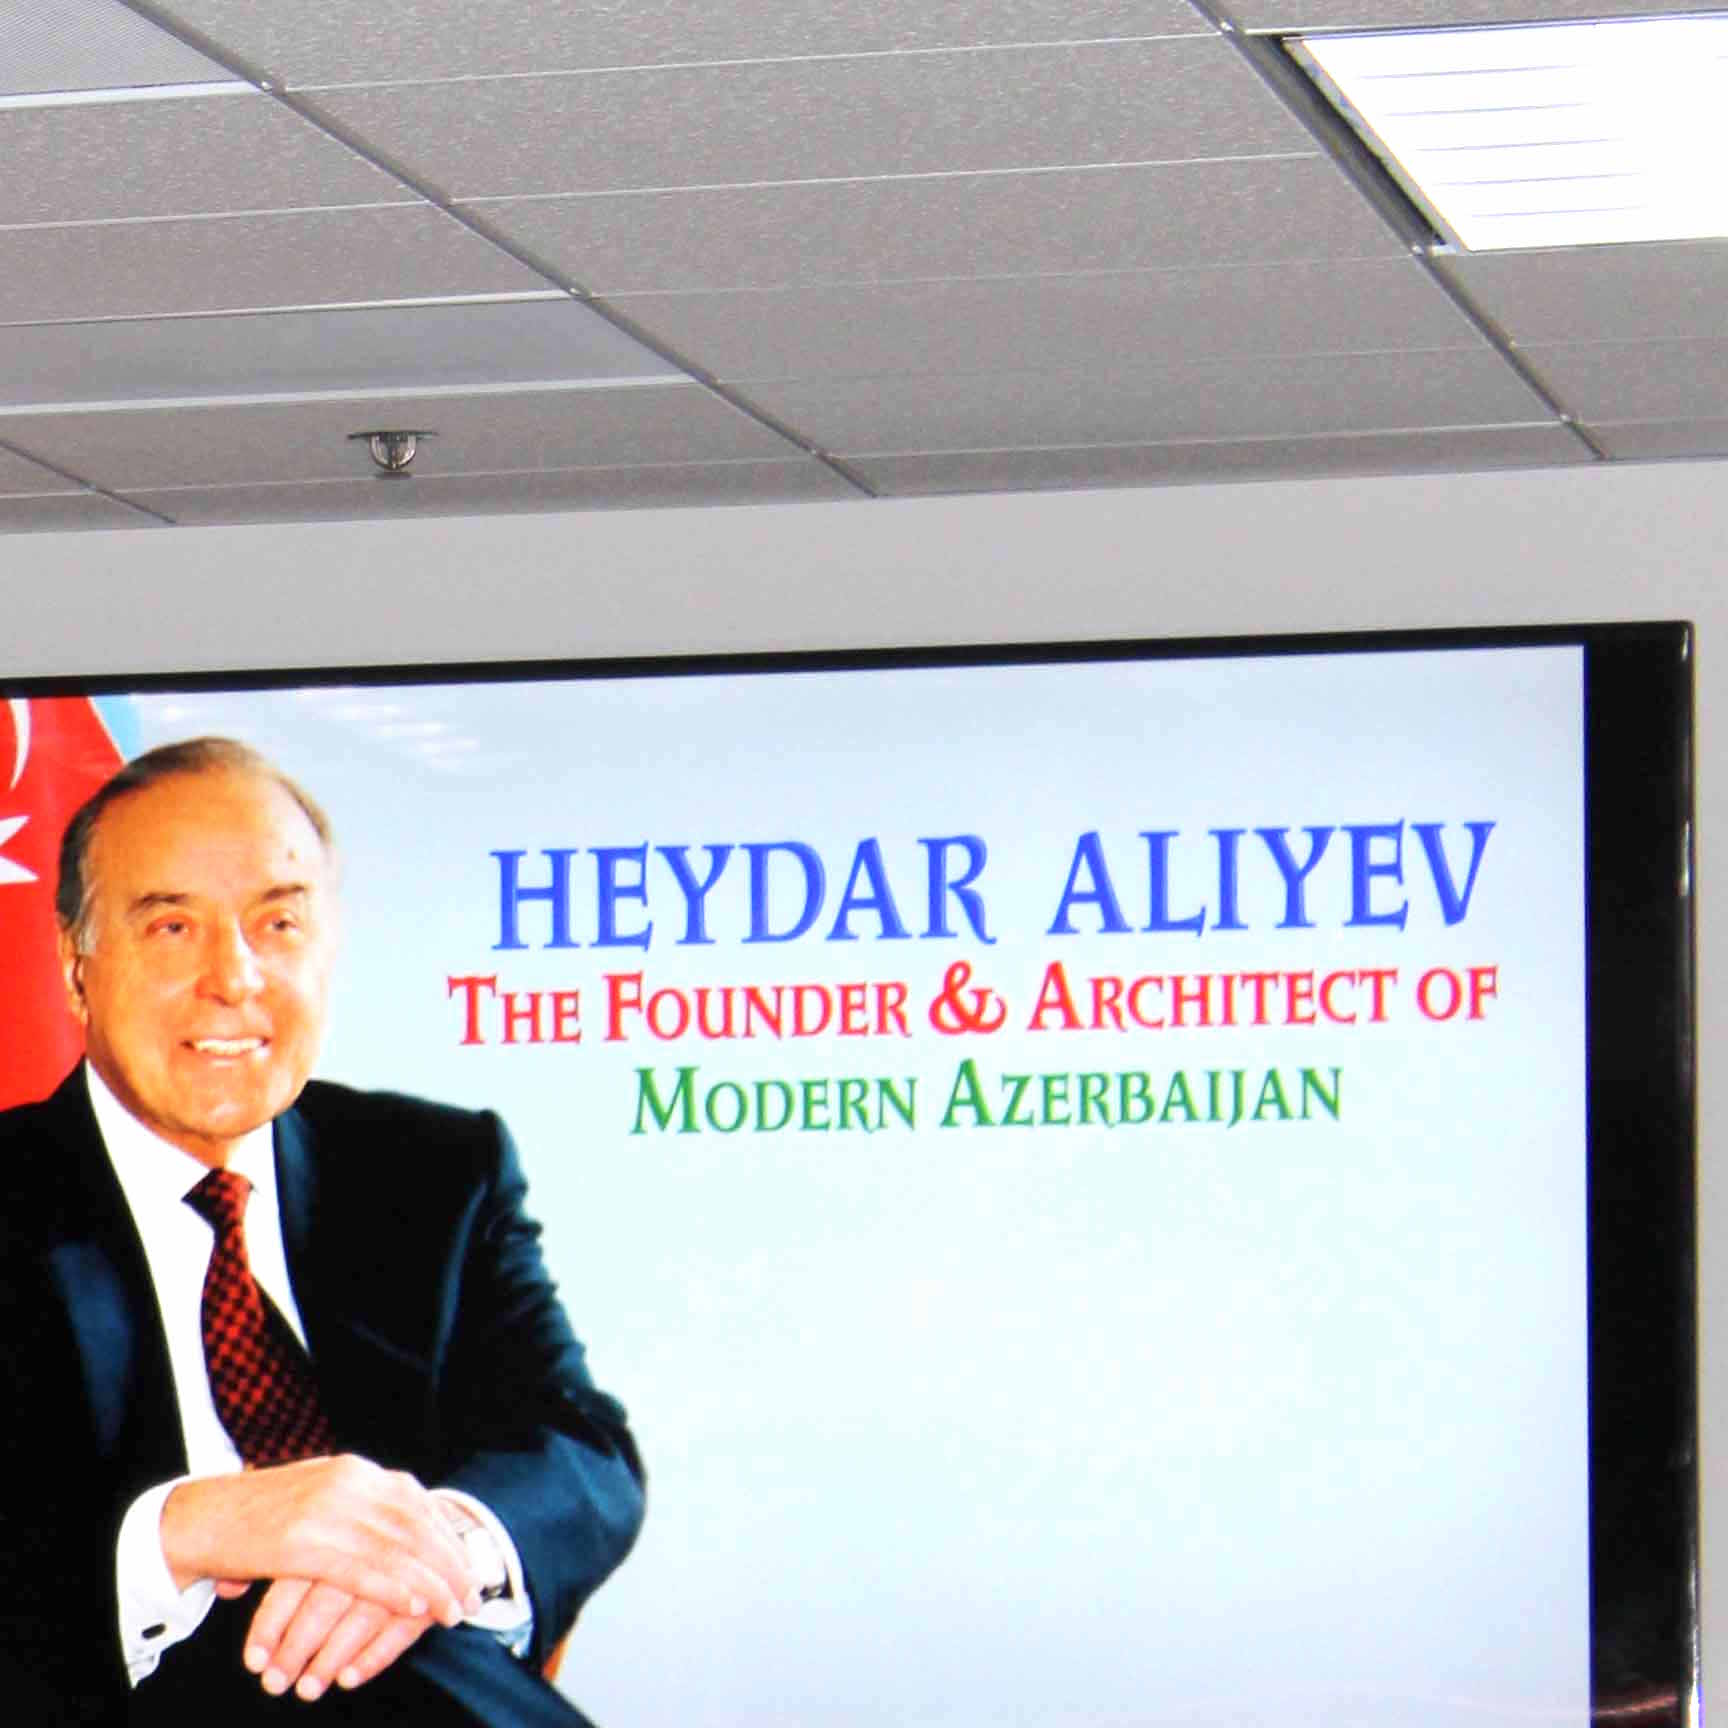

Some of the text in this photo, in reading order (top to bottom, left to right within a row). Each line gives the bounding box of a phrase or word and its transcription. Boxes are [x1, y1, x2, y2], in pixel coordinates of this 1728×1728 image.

[489, 818, 1498, 952] HEYDAR ALIYEV
[447, 959, 1499, 1046] THE FOUNDER & ARCHITECT OF
[628, 1058, 1343, 1136] MODERN AZERBAIJAN
